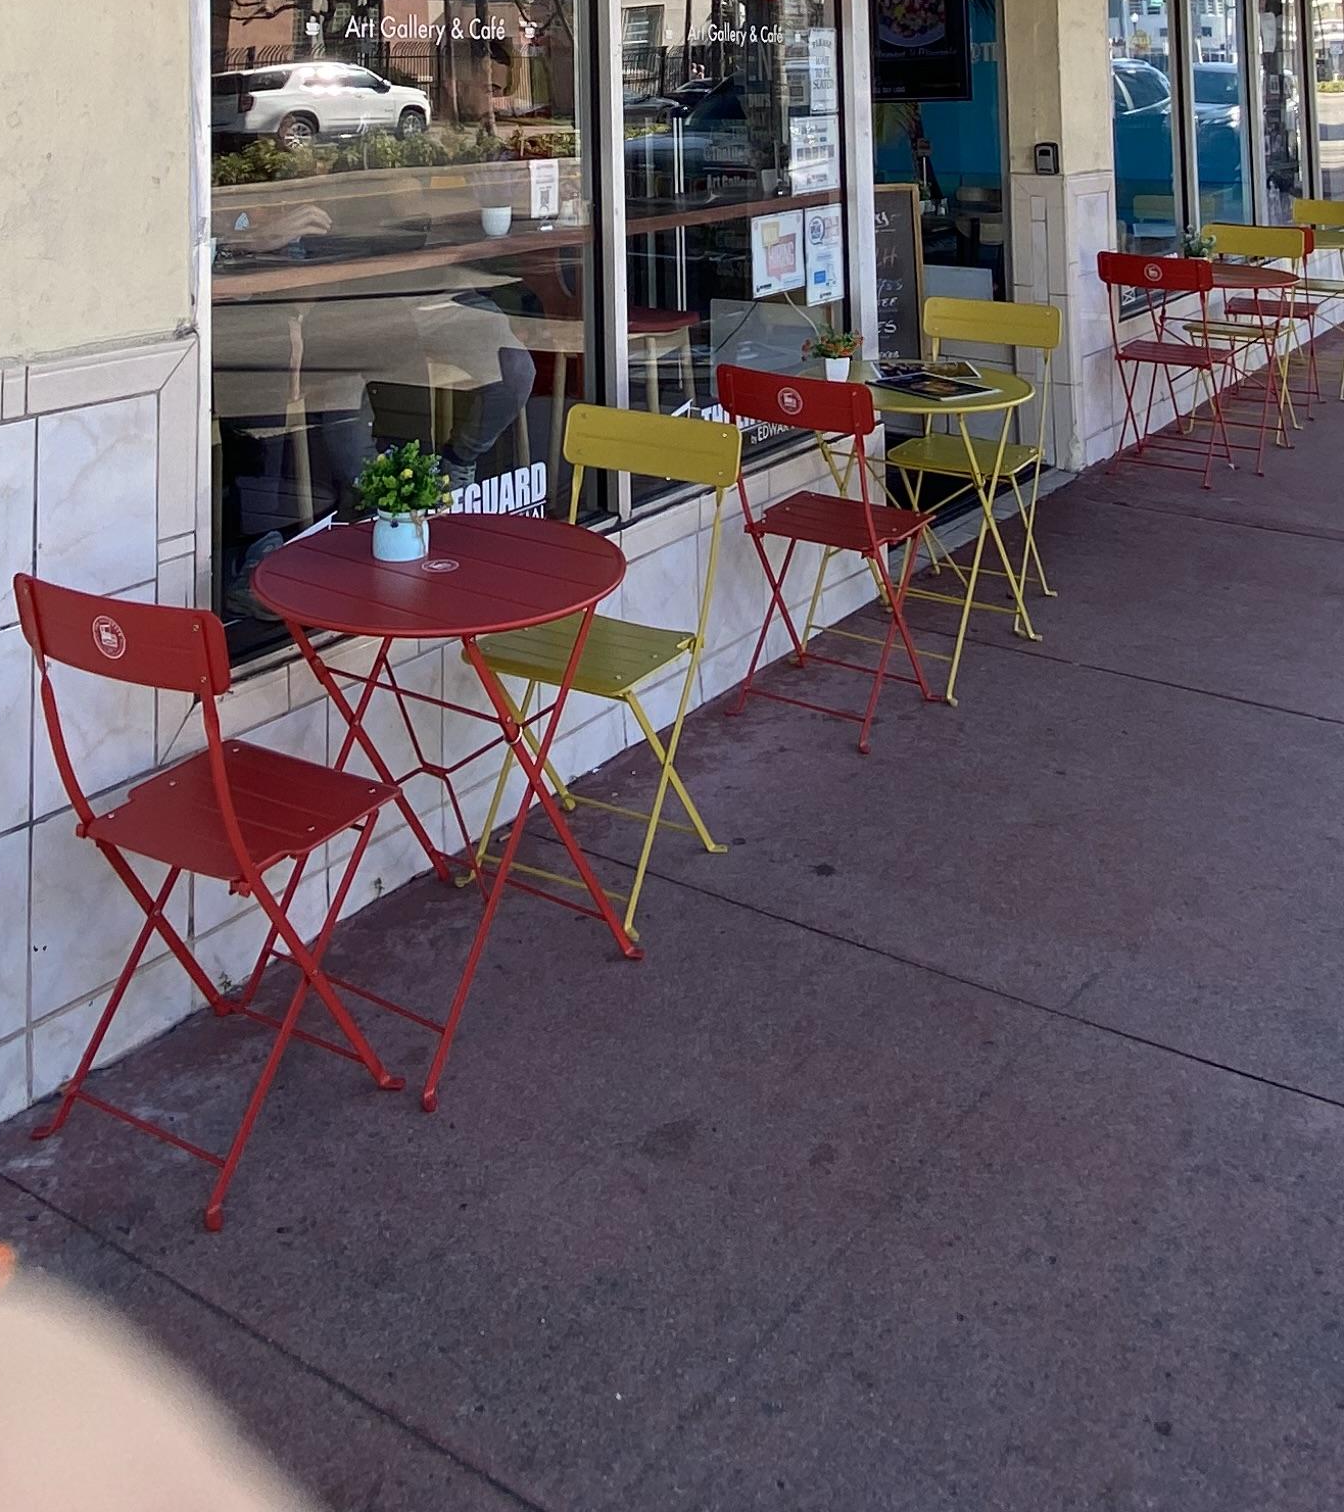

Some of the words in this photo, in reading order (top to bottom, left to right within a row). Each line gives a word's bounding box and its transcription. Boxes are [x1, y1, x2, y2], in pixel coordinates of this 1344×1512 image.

[345, 15, 375, 38] Art
[381, 14, 445, 46] Gallery
[451, 17, 464, 39] &
[470, 15, 506, 40] Café
[708, 22, 747, 47] Gallery
[750, 25, 758, 42] &
[761, 25, 784, 43] Café
[428, 462, 547, 514] EGUARD
